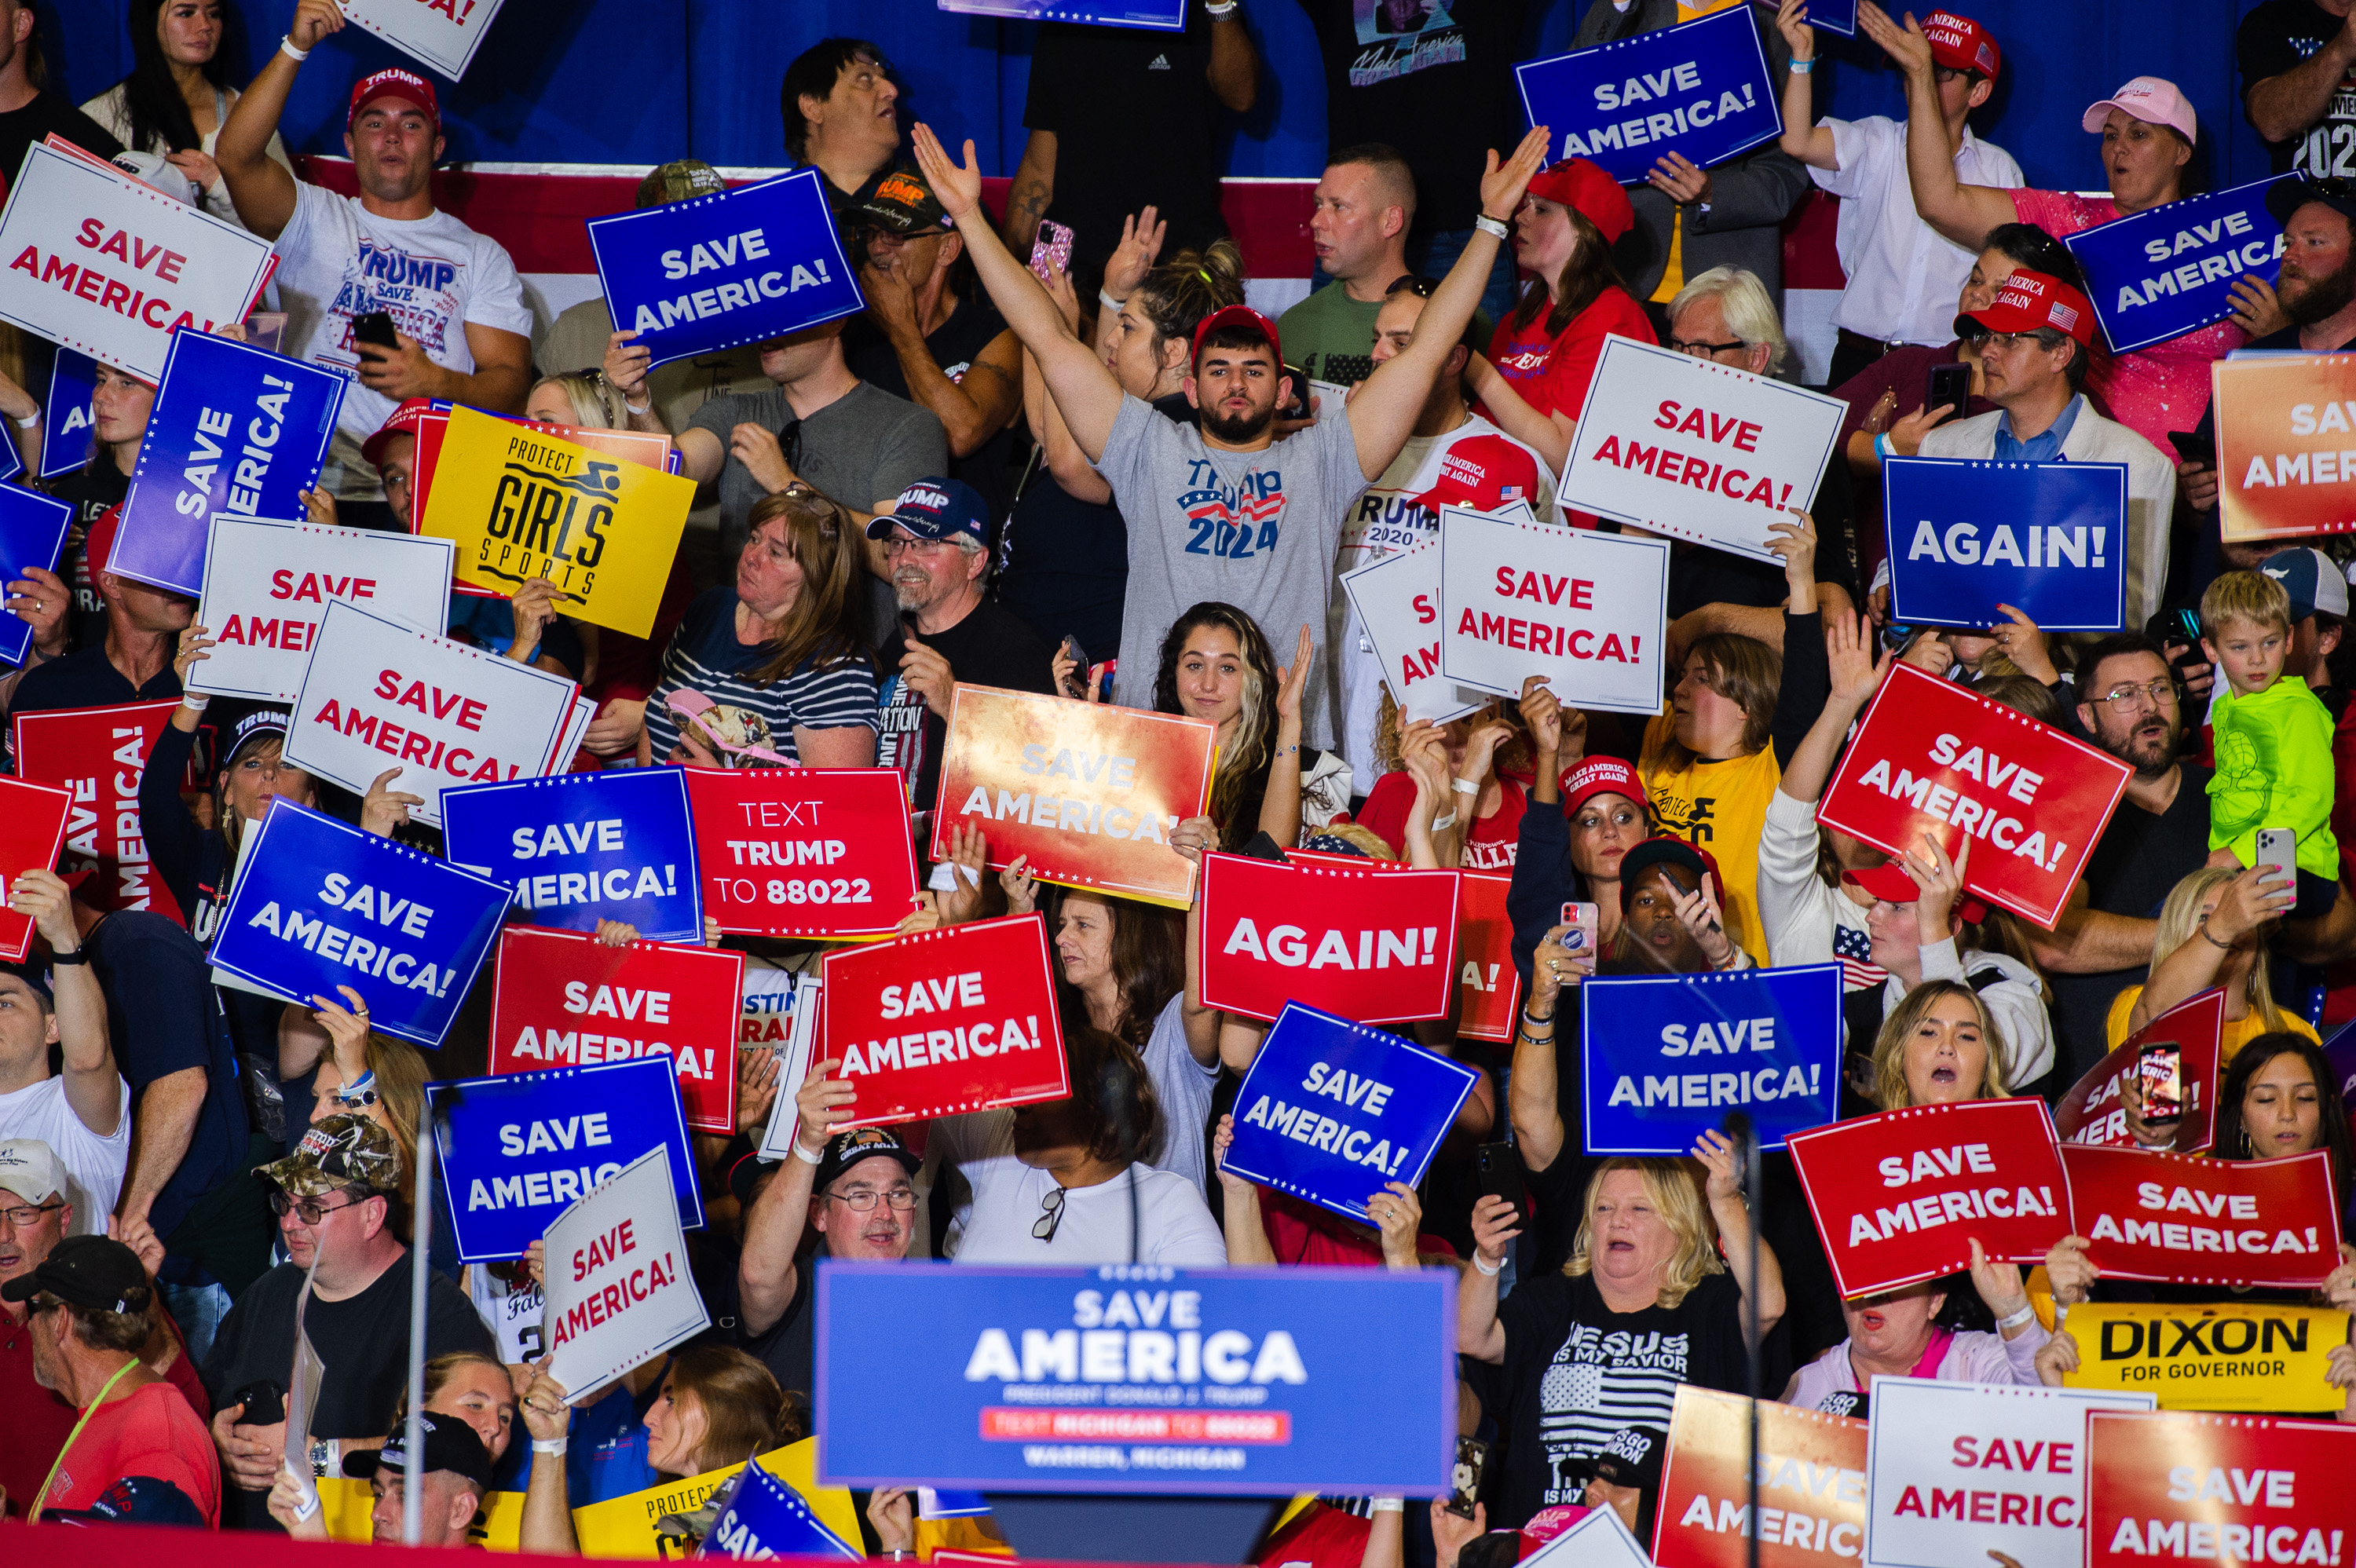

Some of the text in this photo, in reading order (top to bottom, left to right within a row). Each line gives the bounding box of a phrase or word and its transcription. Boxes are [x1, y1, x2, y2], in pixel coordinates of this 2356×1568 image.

[1926, 14, 1972, 35] AMERICA
[1928, 29, 1963, 48] AGAIN
[366, 69, 423, 86] TRUMP
[1593, 60, 1701, 111] SAVE
[1562, 82, 1755, 159] AMERICA!
[75, 217, 187, 283] SAVE
[660, 228, 770, 280] SAVE
[2144, 210, 2254, 263] SAVE
[377, 280, 415, 302] SAVE
[635, 258, 832, 335] AMERICA!
[1999, 291, 2032, 310] AGAIN
[228, 374, 294, 517] ERICA!
[1653, 400, 1763, 453] SAVE
[176, 406, 232, 519] SAVE
[508, 437, 574, 473] PROTECT
[1450, 455, 1485, 478] AMERICA
[1592, 435, 1794, 512] AMERICA!
[1451, 470, 1479, 488] AGAIN
[487, 474, 613, 568] GIRLS
[1185, 517, 1278, 559] 2024
[1369, 527, 1414, 546] 2020
[480, 538, 594, 594] SPORTS
[1908, 520, 2106, 568] AGAIN!
[269, 568, 377, 605] SAVE
[1495, 565, 1595, 611] SAVE
[1458, 607, 1641, 664] AMERICA!
[373, 669, 488, 733] SAVE
[1021, 743, 1136, 788] SAVE
[1565, 763, 1629, 788] MAKE AMERICA
[1570, 772, 1627, 793] GREAT AGAIN
[1928, 732, 2043, 806] SAVE
[112, 726, 151, 911] AMERICA!
[738, 800, 824, 828] TEXT
[960, 786, 1178, 846] AMERICA!
[1857, 758, 2069, 873] AMERICA!
[512, 819, 624, 860] SAVE
[726, 840, 846, 866] TRUMP
[317, 872, 434, 939] SAVE
[714, 877, 873, 905] TO 88022
[248, 901, 457, 999] AMERICA!
[1223, 917, 1438, 970] AGAIN!
[563, 980, 671, 1025] SAVE
[880, 970, 985, 1018] SAVE
[840, 1014, 1038, 1079] AMERICA!
[1660, 1016, 1775, 1056] SAVE
[1301, 1061, 1393, 1116] SAVE
[1608, 1064, 1821, 1107] AMERICA!
[498, 1112, 612, 1157] SAVE
[840, 1142, 871, 1161] GREAT
[1243, 1095, 1410, 1177] AMERICA!
[1879, 1143, 1996, 1187] SAVE
[1849, 1187, 2058, 1248] AMERICA!
[2138, 1182, 2259, 1220] SAVE
[573, 1218, 637, 1283] SAVE
[2091, 1215, 2319, 1254] AMERICA!
[553, 1252, 676, 1351] AMERICA!
[1073, 1289, 1202, 1329] SAVE
[964, 1328, 1308, 1384] AMERICA
[1553, 1321, 1688, 1360] JESUS
[1575, 1347, 1608, 1364] MY
[1612, 1354, 1688, 1373] SAVIOR
[2101, 1318, 2310, 1361] DIXON
[2121, 1361, 2285, 1382] FOR GOVERNOR
[1952, 1435, 2074, 1474] SAVE
[646, 1484, 714, 1518] PROTECT
[1545, 1489, 1582, 1504] IS MY
[1894, 1486, 2084, 1529] AMERIC
[2168, 1466, 2295, 1508] SAVE
[2109, 1518, 2343, 1566] AMERICA!
